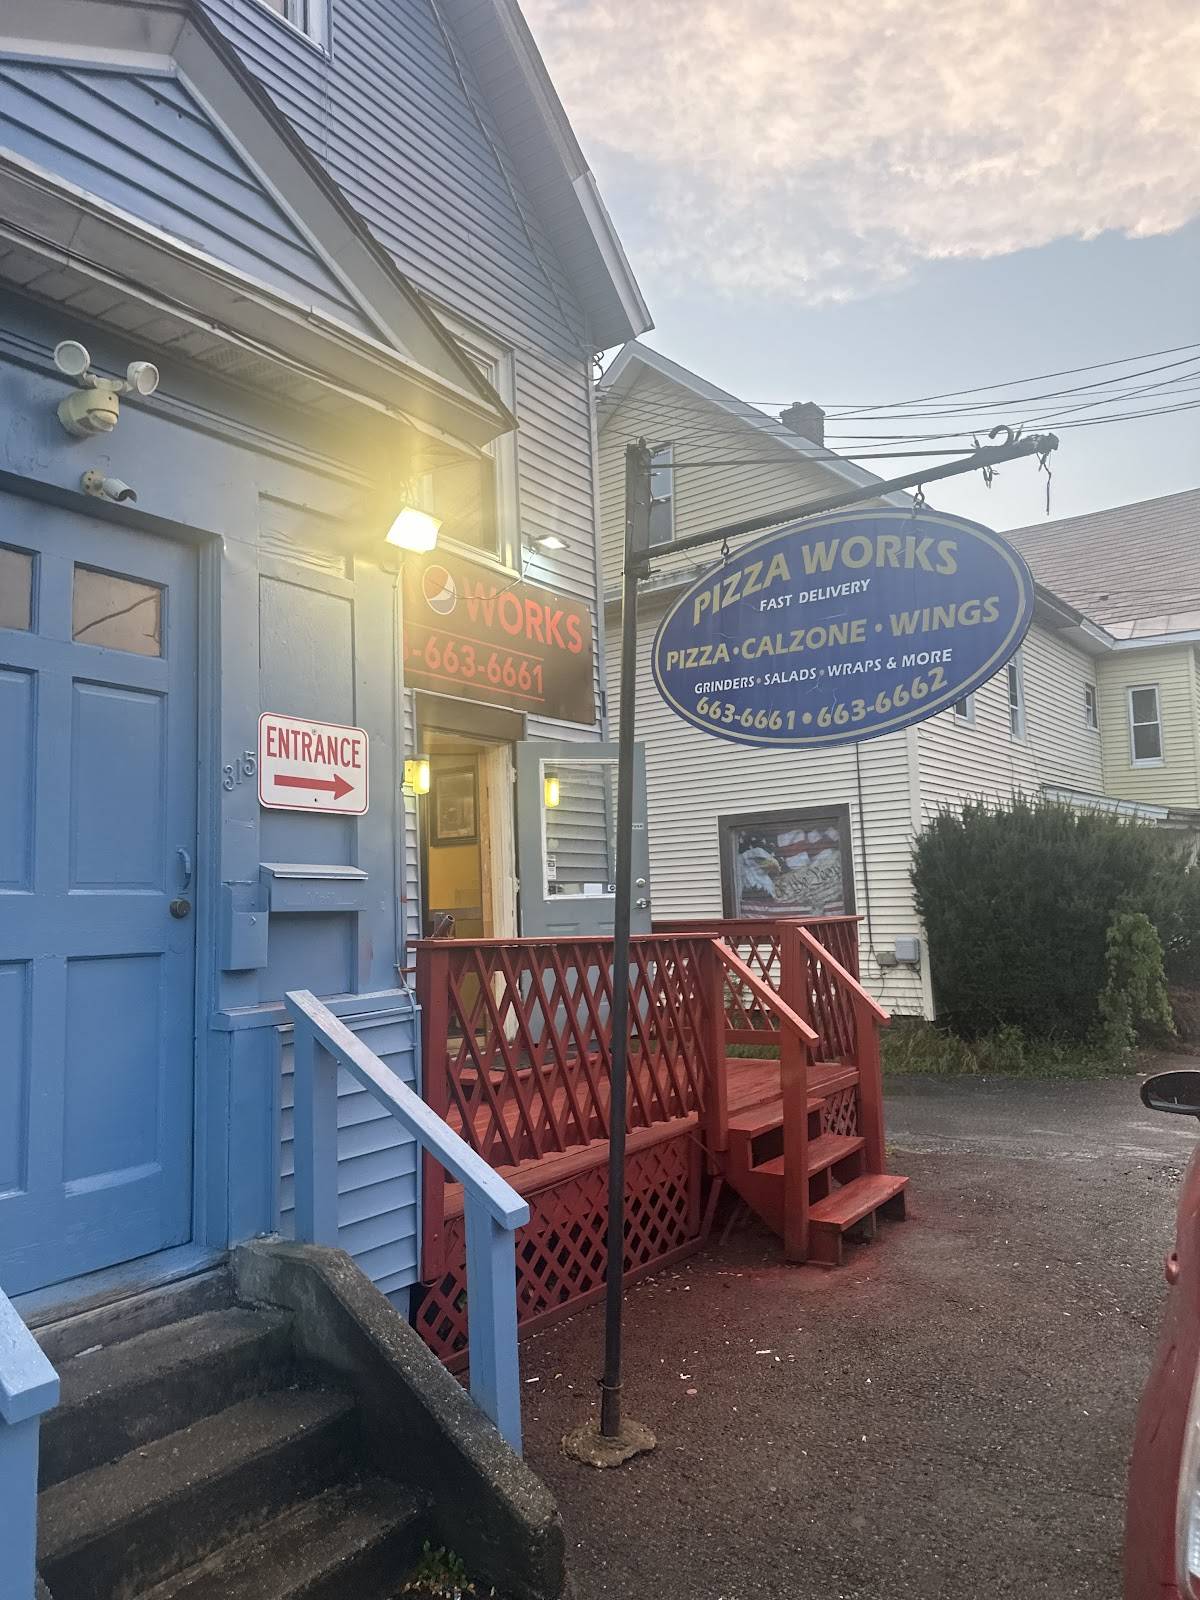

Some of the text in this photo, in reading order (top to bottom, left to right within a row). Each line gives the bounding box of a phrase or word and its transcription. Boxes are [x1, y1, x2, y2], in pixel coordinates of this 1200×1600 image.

[693, 534, 958, 626] PIZZA WORKS
[759, 578, 871, 612] FAST DELIVERY
[464, 576, 583, 655] WORKS
[666, 596, 1000, 671] PIZZA CALZONE WINGS
[694, 648, 953, 694] GRINDERS SALADS WRAPS & MORE
[696, 666, 948, 730] 663-6661 663-6662
[223, 750, 257, 791] 315
[266, 725, 362, 769] ENTRANCE
